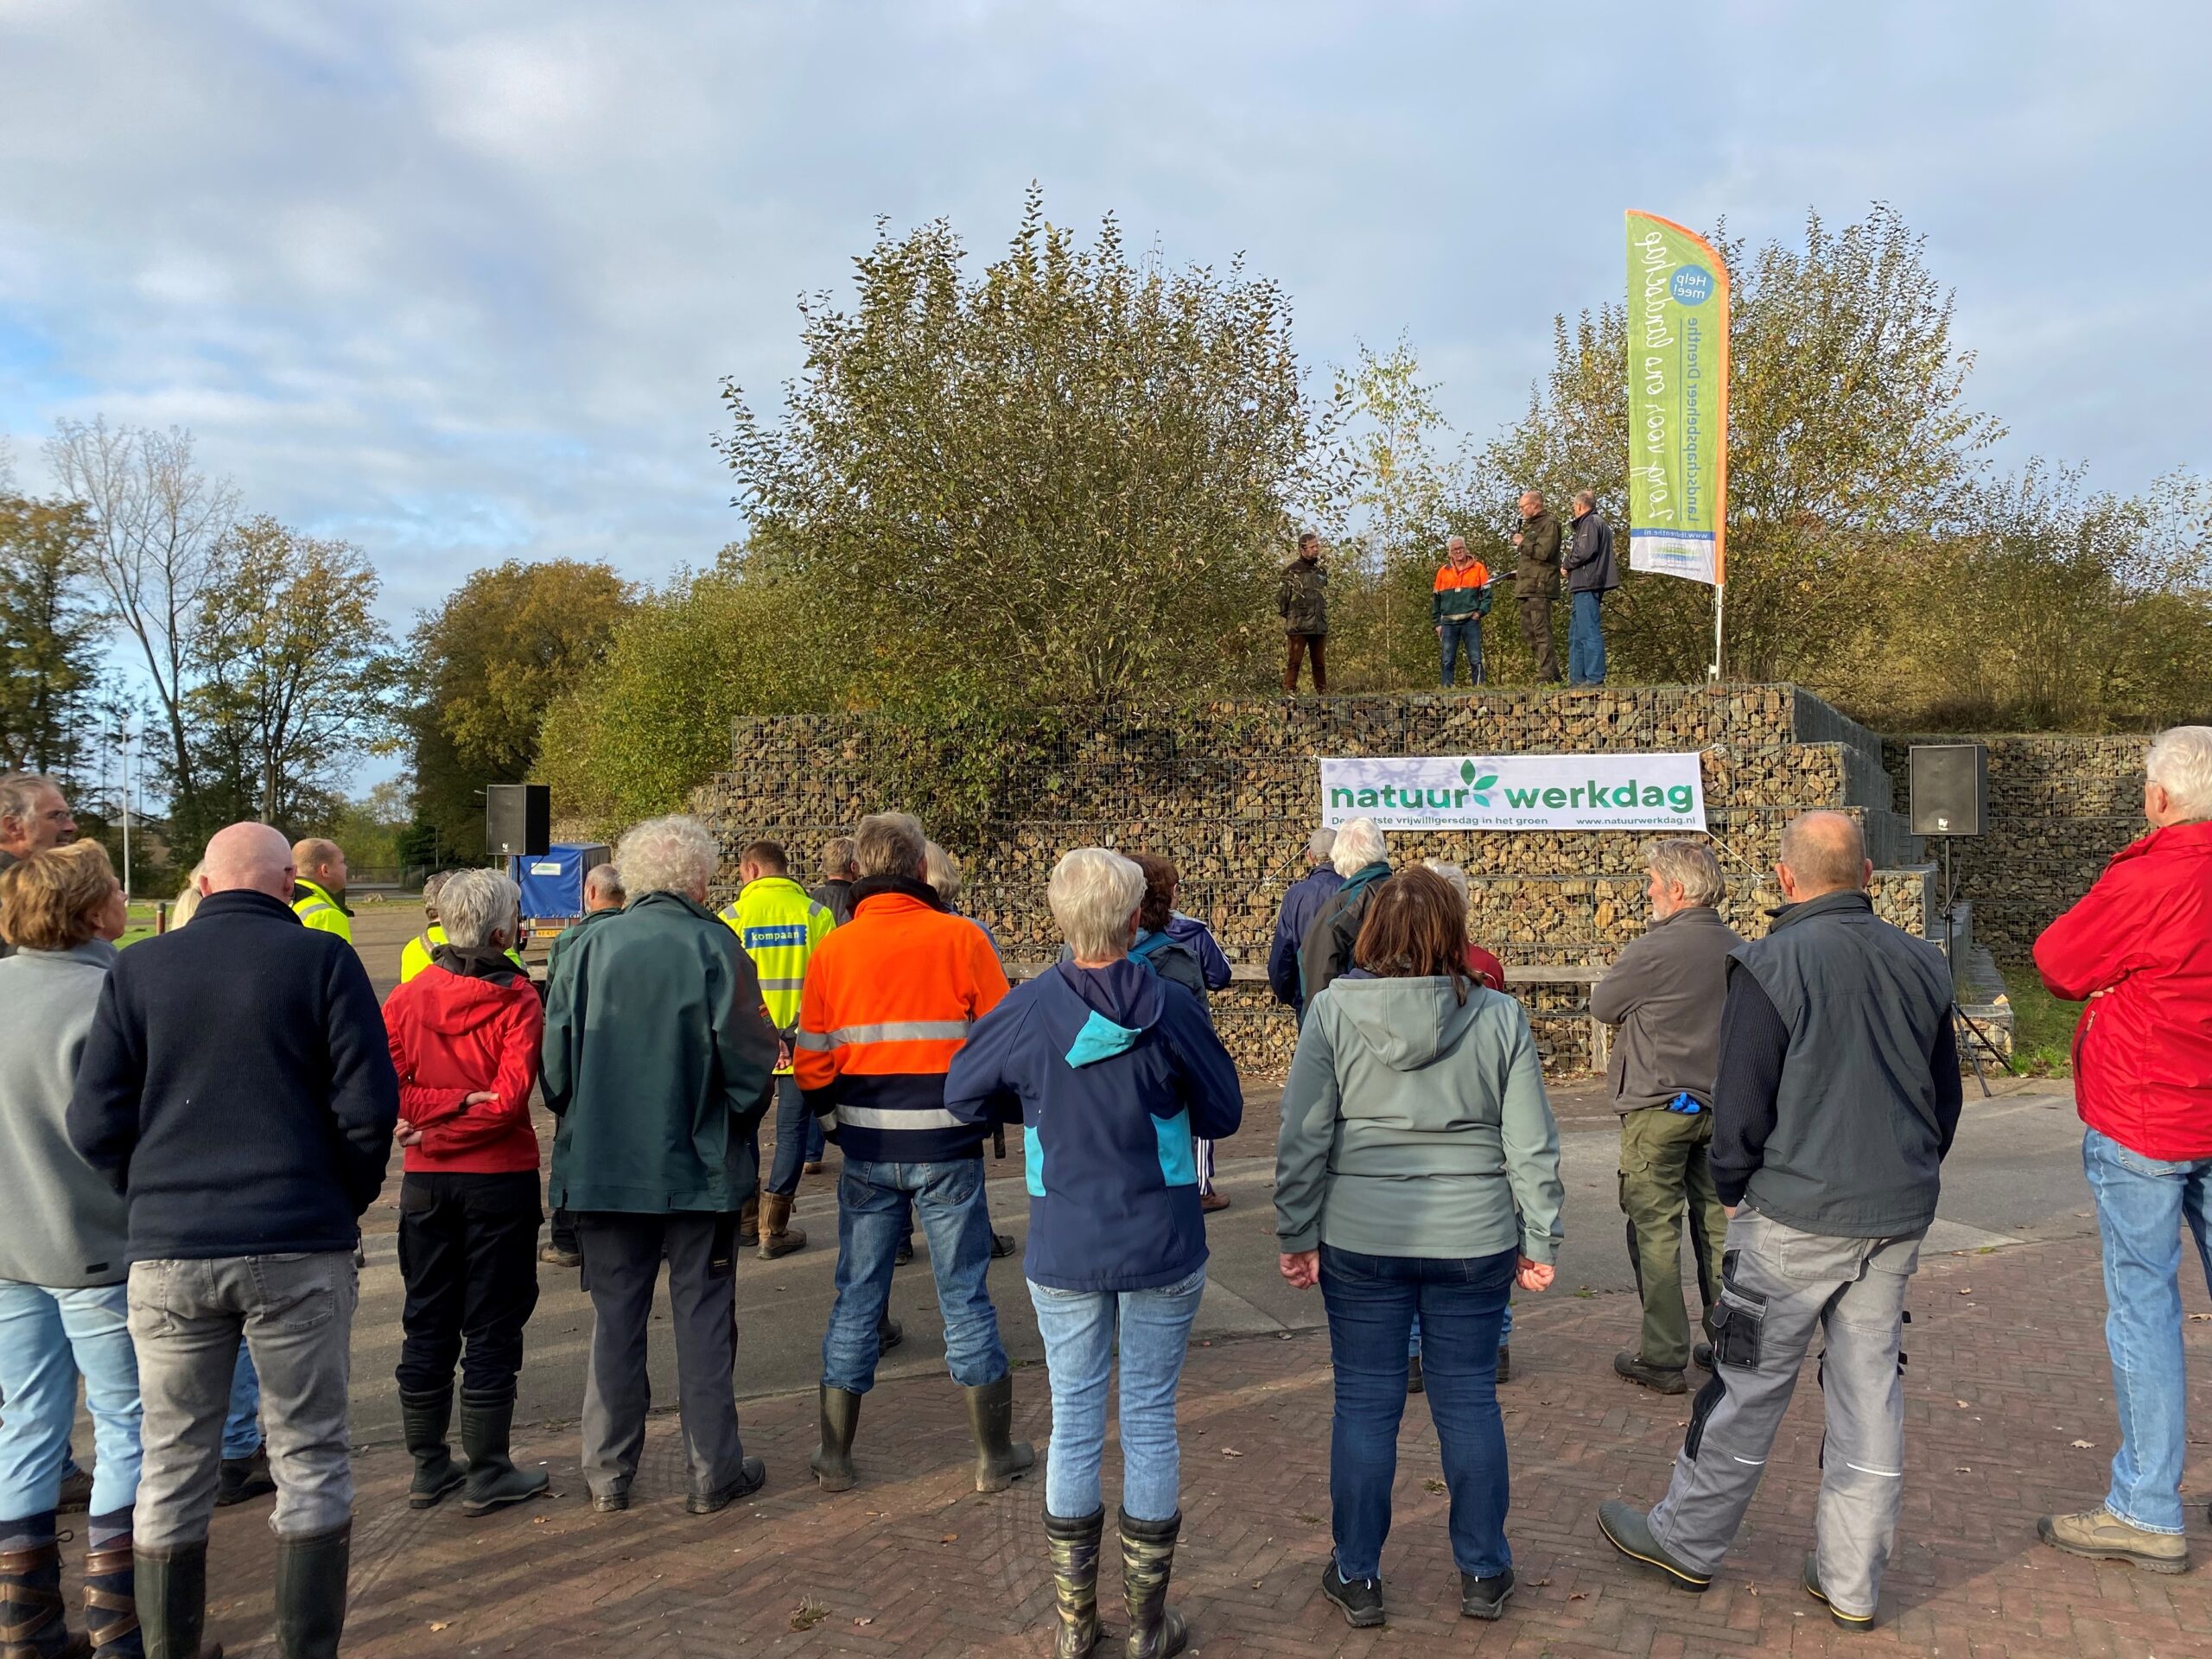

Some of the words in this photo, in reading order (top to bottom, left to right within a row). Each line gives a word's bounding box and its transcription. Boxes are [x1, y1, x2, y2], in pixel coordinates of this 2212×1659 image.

[1332, 785, 1470, 809] natuur
[1504, 779, 1694, 814] werkdag
[1396, 816, 1479, 826] vrijwilligersdag
[1482, 816, 1492, 824] in
[1516, 817, 1548, 826] groen
[1576, 816, 1696, 826] www.natuurwerkdag.nl
[751, 931, 799, 942] kompaan
